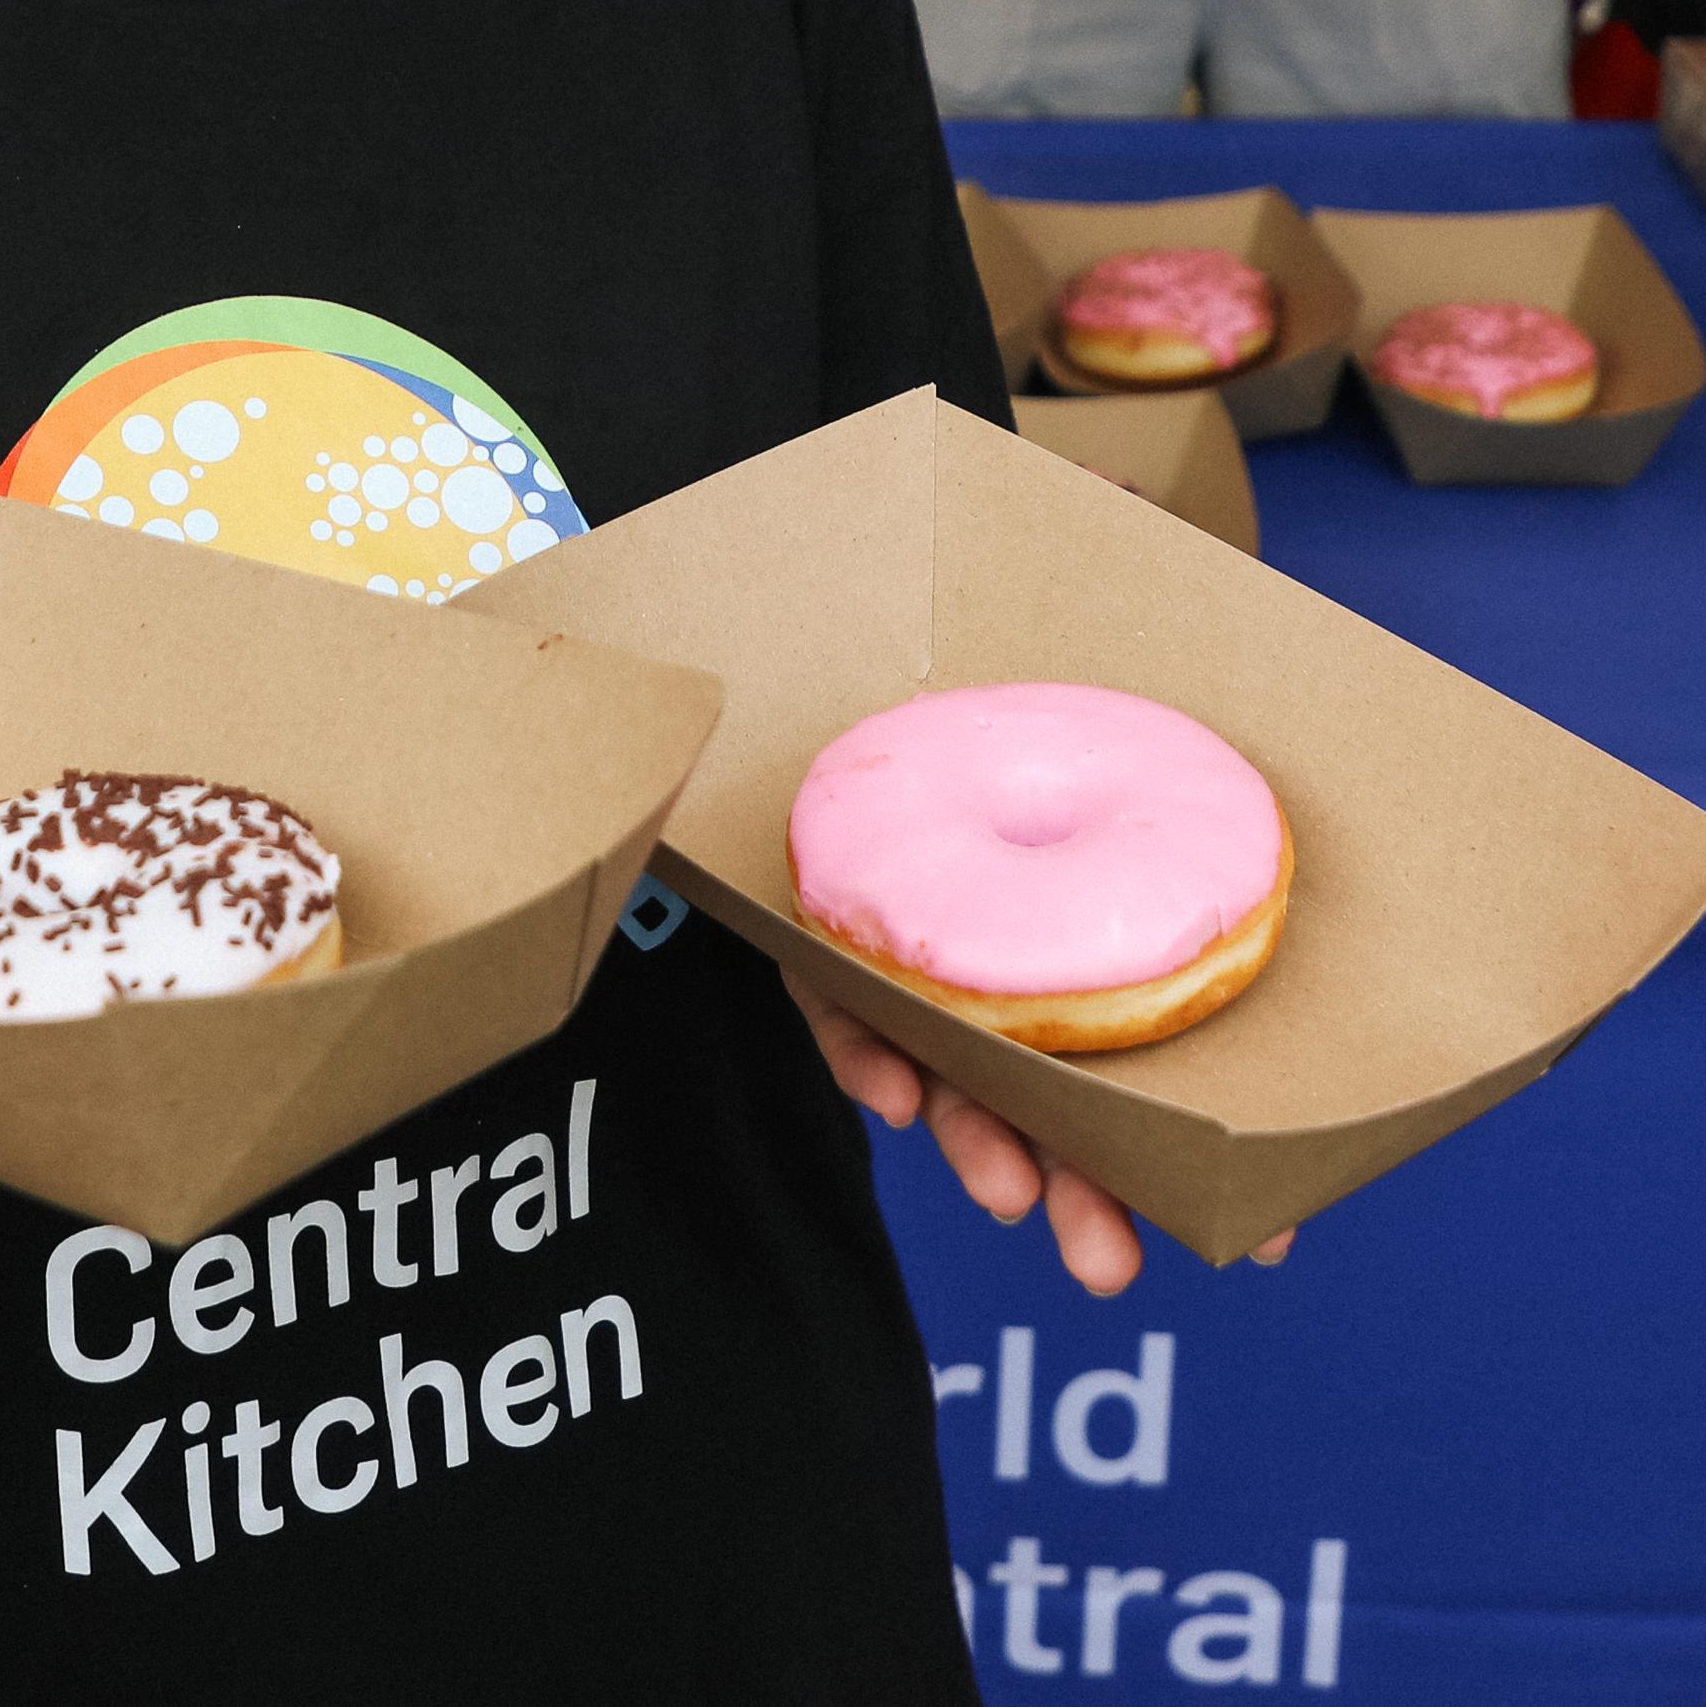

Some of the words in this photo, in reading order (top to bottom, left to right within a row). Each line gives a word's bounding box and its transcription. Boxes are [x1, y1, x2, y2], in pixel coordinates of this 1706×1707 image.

[44, 1078, 597, 1384] Central
[55, 1294, 644, 1576] Kitchen
[953, 1537, 1347, 1687] tral
